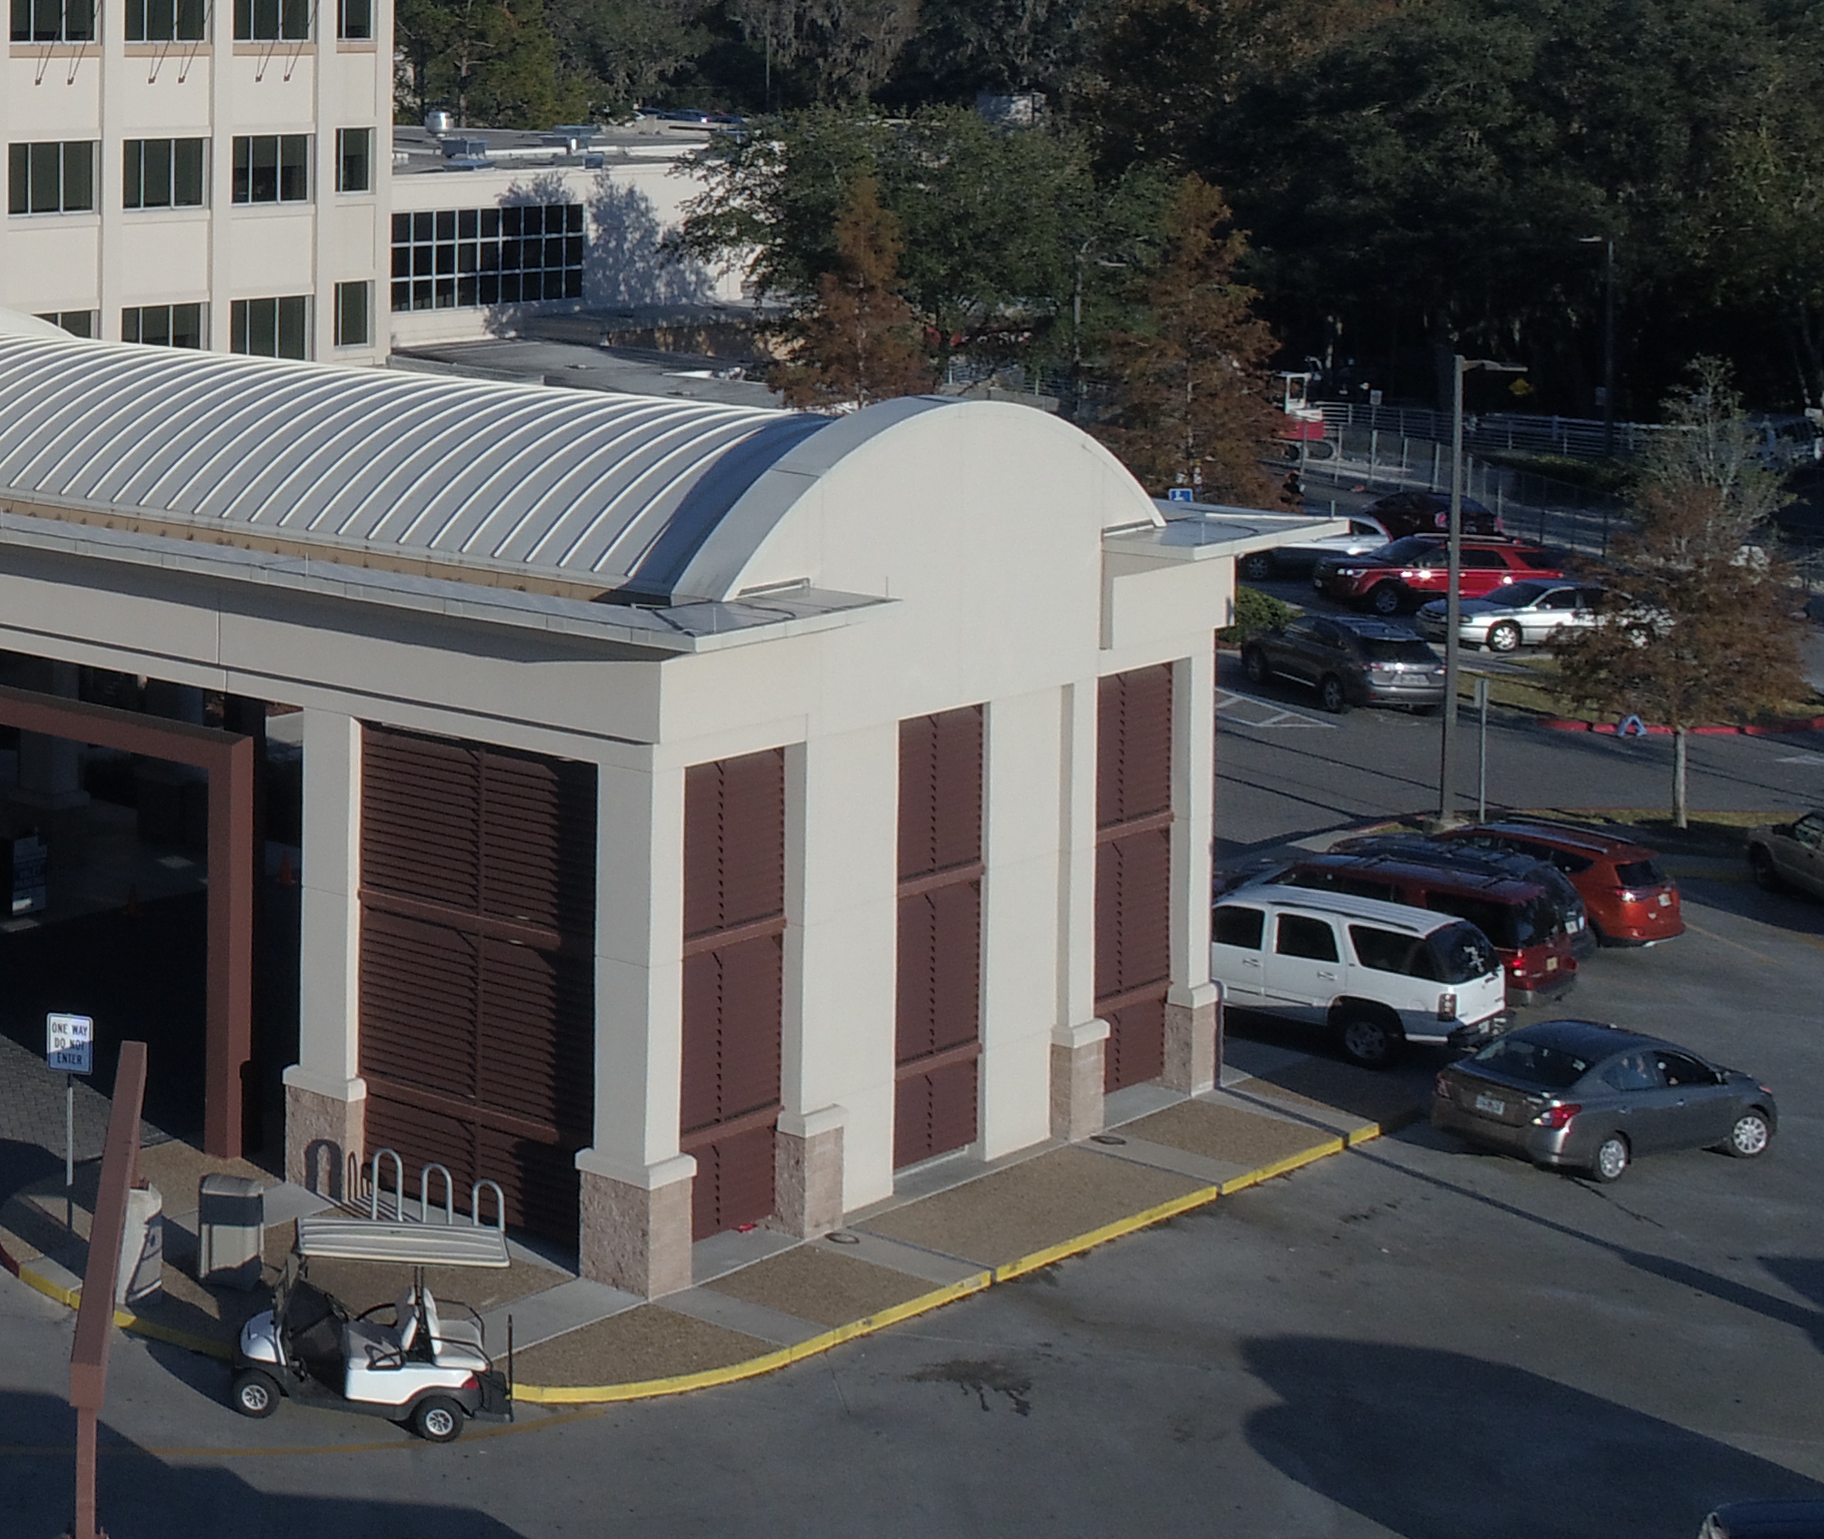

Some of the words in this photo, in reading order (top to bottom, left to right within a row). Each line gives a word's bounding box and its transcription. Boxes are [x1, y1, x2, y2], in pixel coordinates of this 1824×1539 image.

[52, 1022, 68, 1035] ONE
[71, 1024, 88, 1037] WAY
[54, 1037, 66, 1049] DO
[69, 1039, 84, 1051] NOT
[57, 1052, 83, 1065] ENTER
